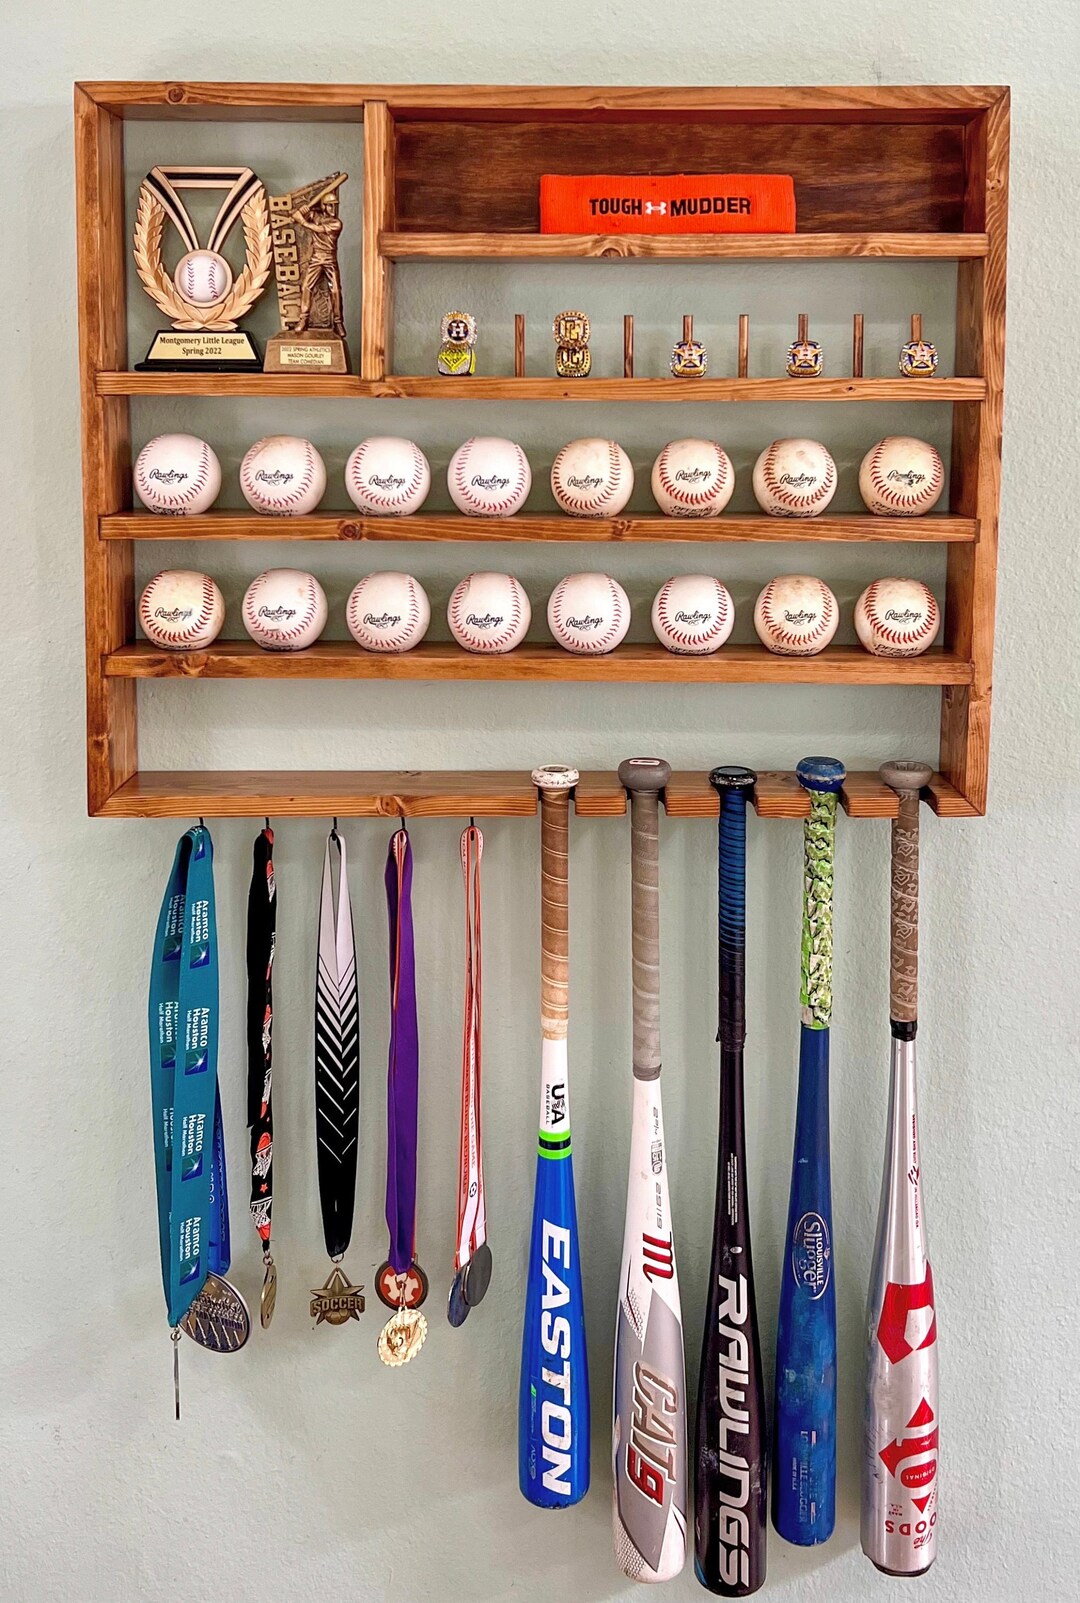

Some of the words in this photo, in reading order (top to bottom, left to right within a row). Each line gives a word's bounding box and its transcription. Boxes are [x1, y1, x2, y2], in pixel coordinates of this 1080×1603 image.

[589, 198, 642, 216] TOUGH
[670, 196, 751, 217] MUDDER
[269, 196, 301, 330] BASEBALL
[160, 336, 200, 345] Montgomery
[221, 336, 244, 345] League
[182, 347, 204, 356] Spring
[150, 469, 188, 482] Rawlings
[255, 469, 294, 482] Rawlings
[368, 474, 406, 488] Rawlings
[471, 474, 510, 488] Rawlings
[567, 474, 604, 488] Rawlings
[675, 467, 712, 482] Rawlings
[780, 472, 817, 486] Rawlings
[888, 469, 925, 484] Rlings
[154, 606, 192, 619] Rawlings
[258, 606, 297, 619] Rawlings
[362, 613, 402, 626] Rawlings
[466, 613, 504, 626] Rawlings
[675, 610, 712, 624] Rawlings
[784, 610, 816, 622] Rawlings
[885, 609, 922, 622] Rawlings
[565, 615, 603, 629] Rawlings
[877, 644, 918, 652] OFFICIAL
[170, 895, 180, 936] Houston
[165, 1001, 173, 1043] Houston
[192, 1008, 200, 1049] Houston
[200, 1008, 210, 1047] Aramco
[188, 1114, 196, 1155] Houston
[195, 1114, 206, 1152] Aramco
[193, 1216, 202, 1256] Aramco
[799, 1221, 822, 1289] Slugger
[313, 1298, 362, 1313] SOCCER
[541, 1218, 572, 1496] EASTON
[625, 1360, 678, 1508] CAT9
[718, 1274, 750, 1588] RAWLINGS
[906, 1466, 935, 1480] ORIGINAL
[885, 1512, 936, 1536] OODS
[914, 1530, 932, 1549] The
